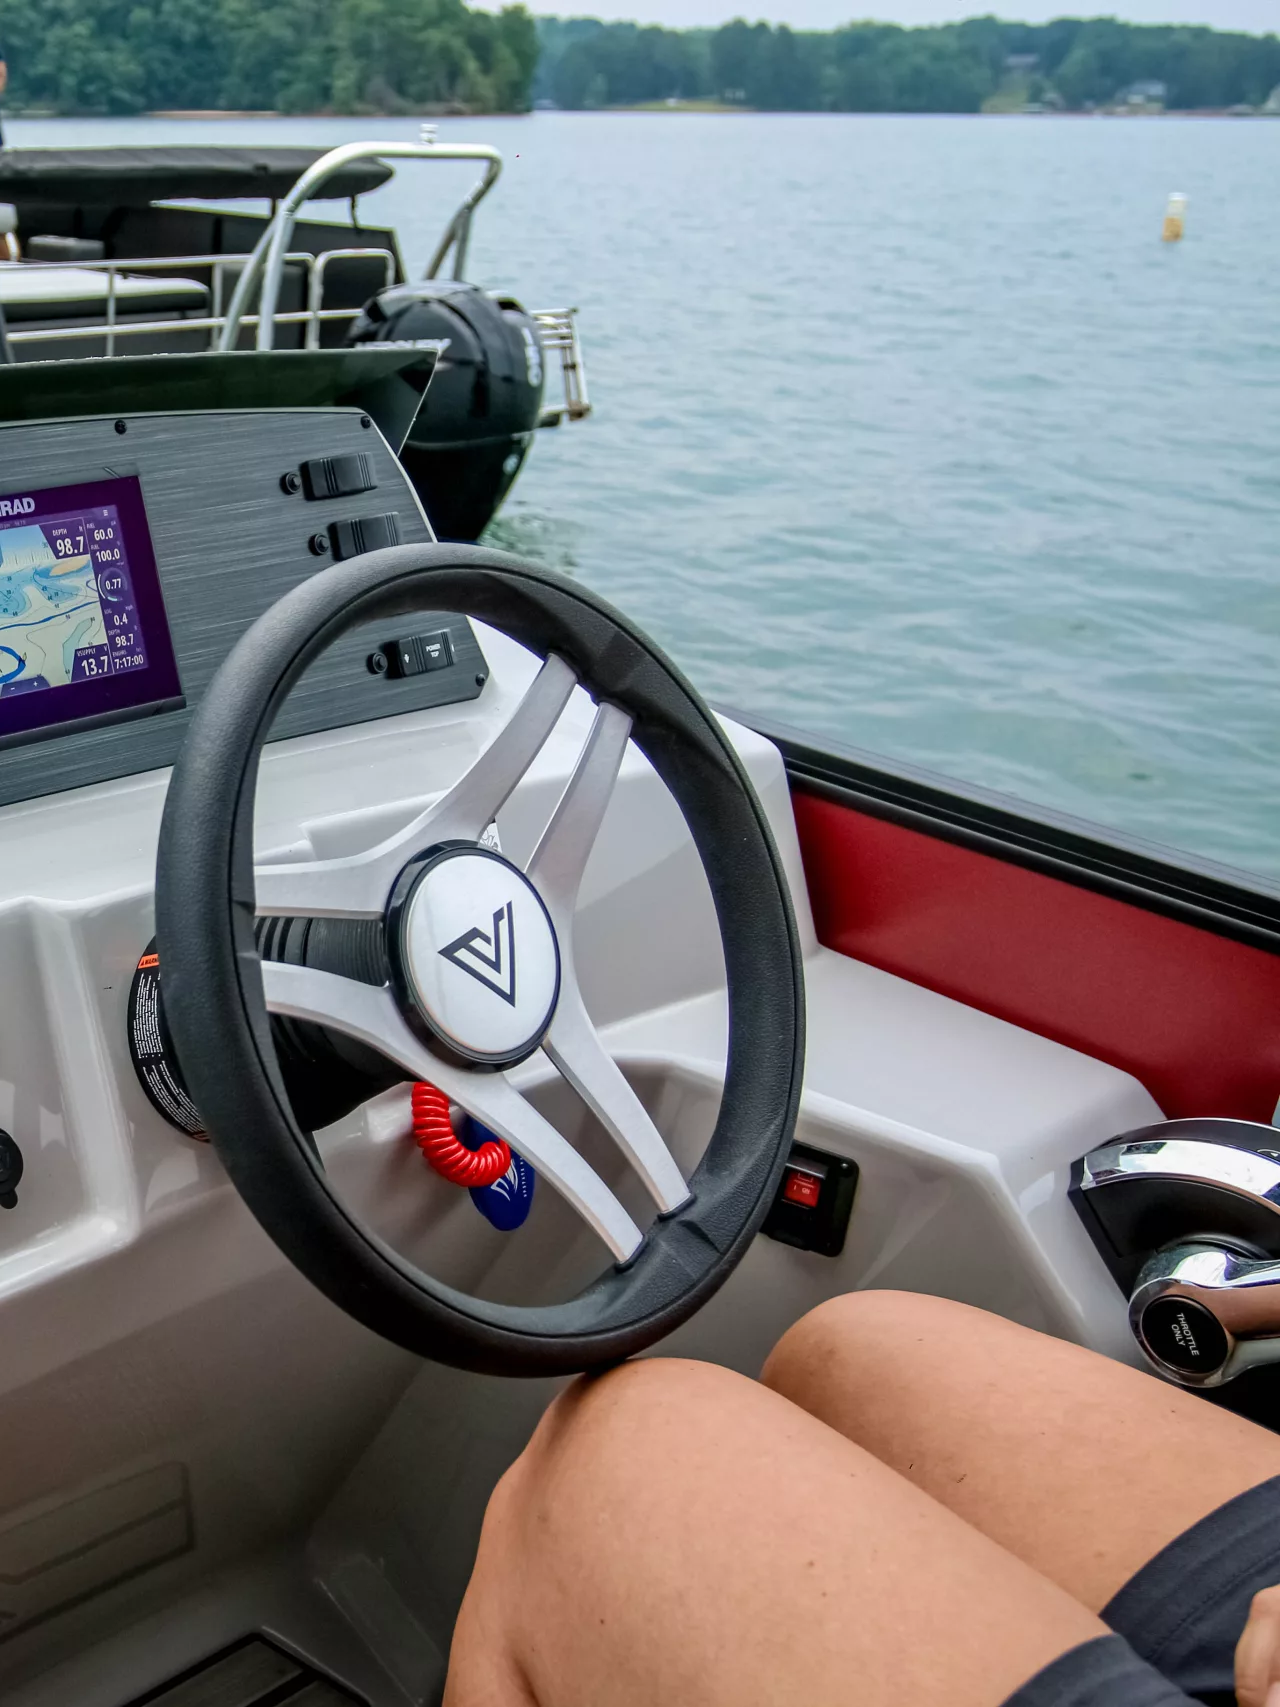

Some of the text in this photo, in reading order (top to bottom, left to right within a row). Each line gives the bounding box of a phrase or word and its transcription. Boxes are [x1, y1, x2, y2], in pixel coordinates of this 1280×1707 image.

[52, 528, 68, 536] DEPTH
[93, 527, 114, 541] 60.0
[56, 535, 84, 557] 98.7
[95, 548, 121, 563] 100.0
[105, 578, 122, 590] 0.77
[113, 613, 129, 626] 0.4
[115, 633, 134, 648] 98.7
[81, 655, 108, 676] 13.7
[114, 654, 144, 670] 7:17:00
[1171, 1324, 1186, 1346] ONLY
[1176, 1312, 1200, 1356] THROTTLE
